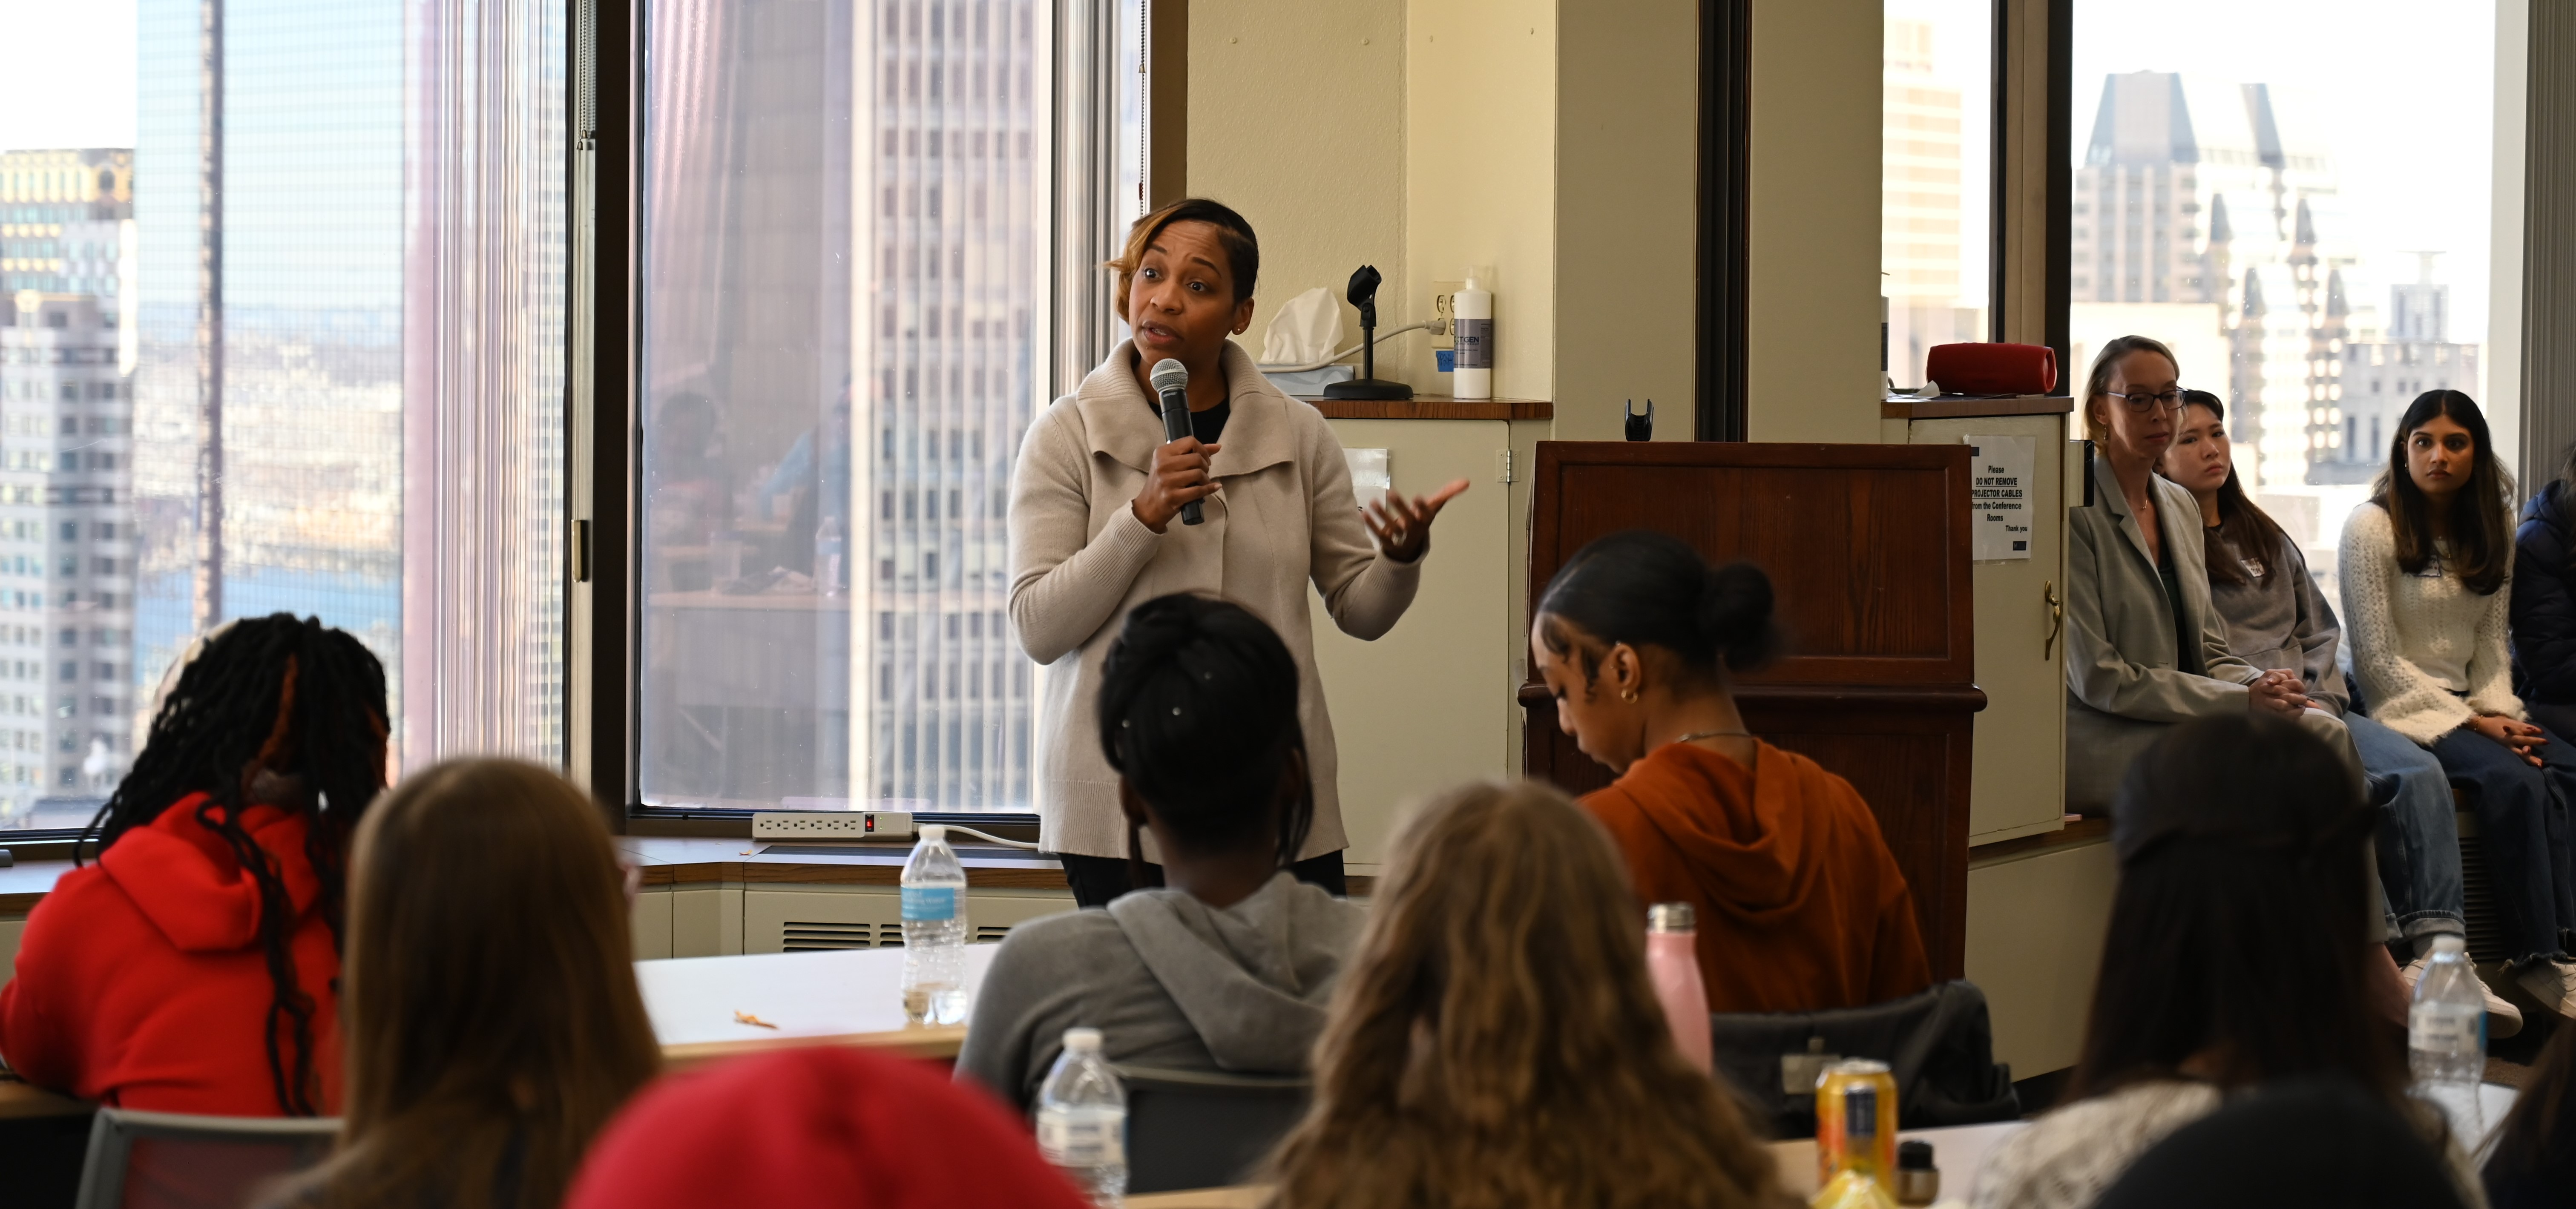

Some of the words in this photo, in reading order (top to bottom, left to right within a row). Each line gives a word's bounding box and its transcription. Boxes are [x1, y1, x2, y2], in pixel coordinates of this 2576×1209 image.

[1972, 489, 2000, 497] PROJECTOR
[2001, 489, 2022, 497] CABLES
[1992, 501, 2021, 509] Conference
